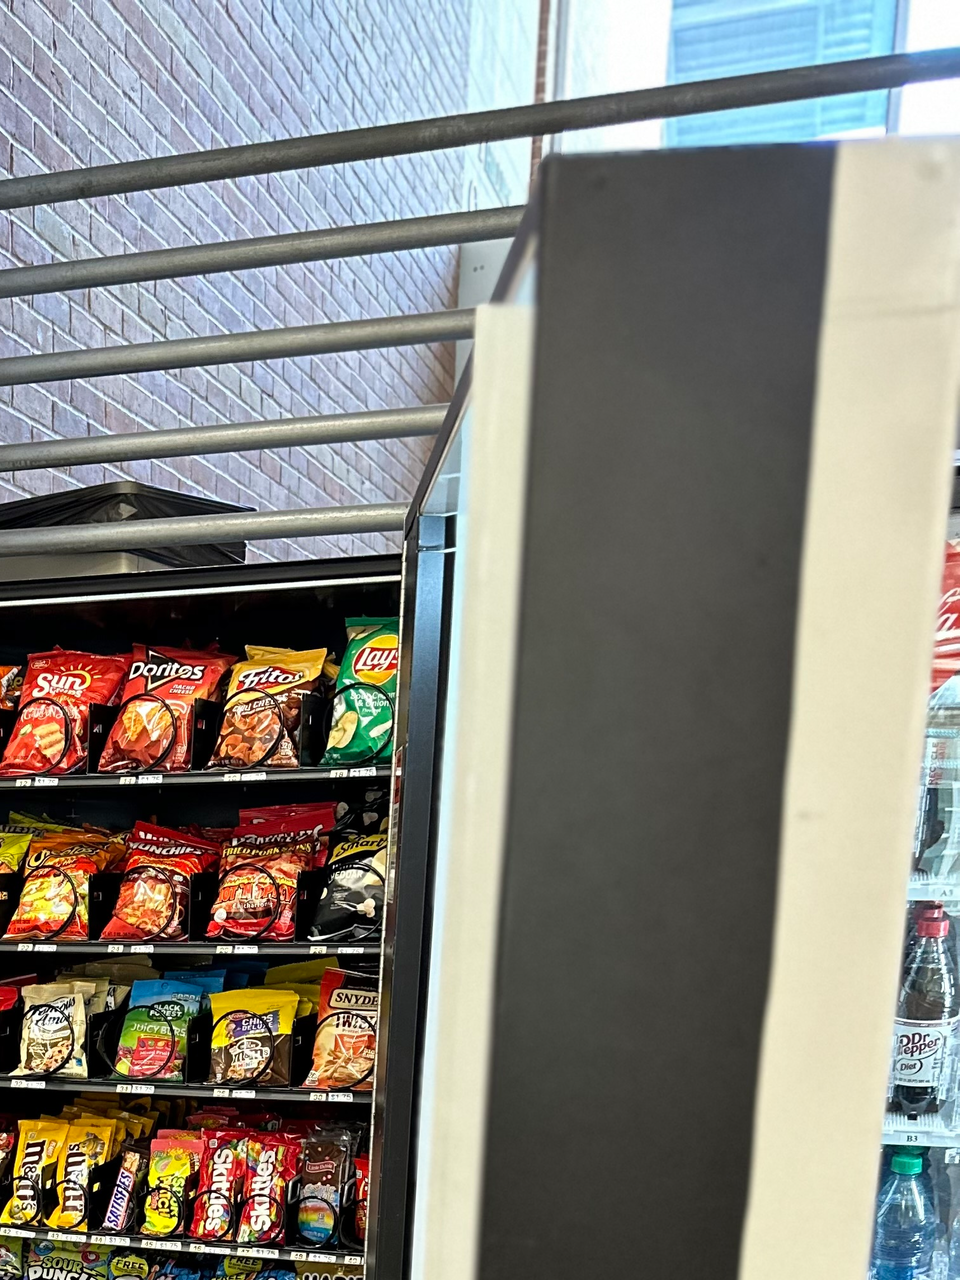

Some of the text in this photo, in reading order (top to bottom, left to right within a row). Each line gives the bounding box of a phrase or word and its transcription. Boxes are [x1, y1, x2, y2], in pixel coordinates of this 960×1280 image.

[128, 662, 205, 681] Doritos
[239, 666, 304, 691] Fritos
[31, 673, 91, 697] Sun
[911, 1032, 930, 1044] Dr
[900, 1062, 917, 1072] Diet
[906, 1134, 918, 1143] B3
[205, 1147, 234, 1232] Skittles
[249, 1149, 277, 1232] Skittles
[41, 1256, 84, 1273] SOUR
[115, 1259, 146, 1271] FREE
